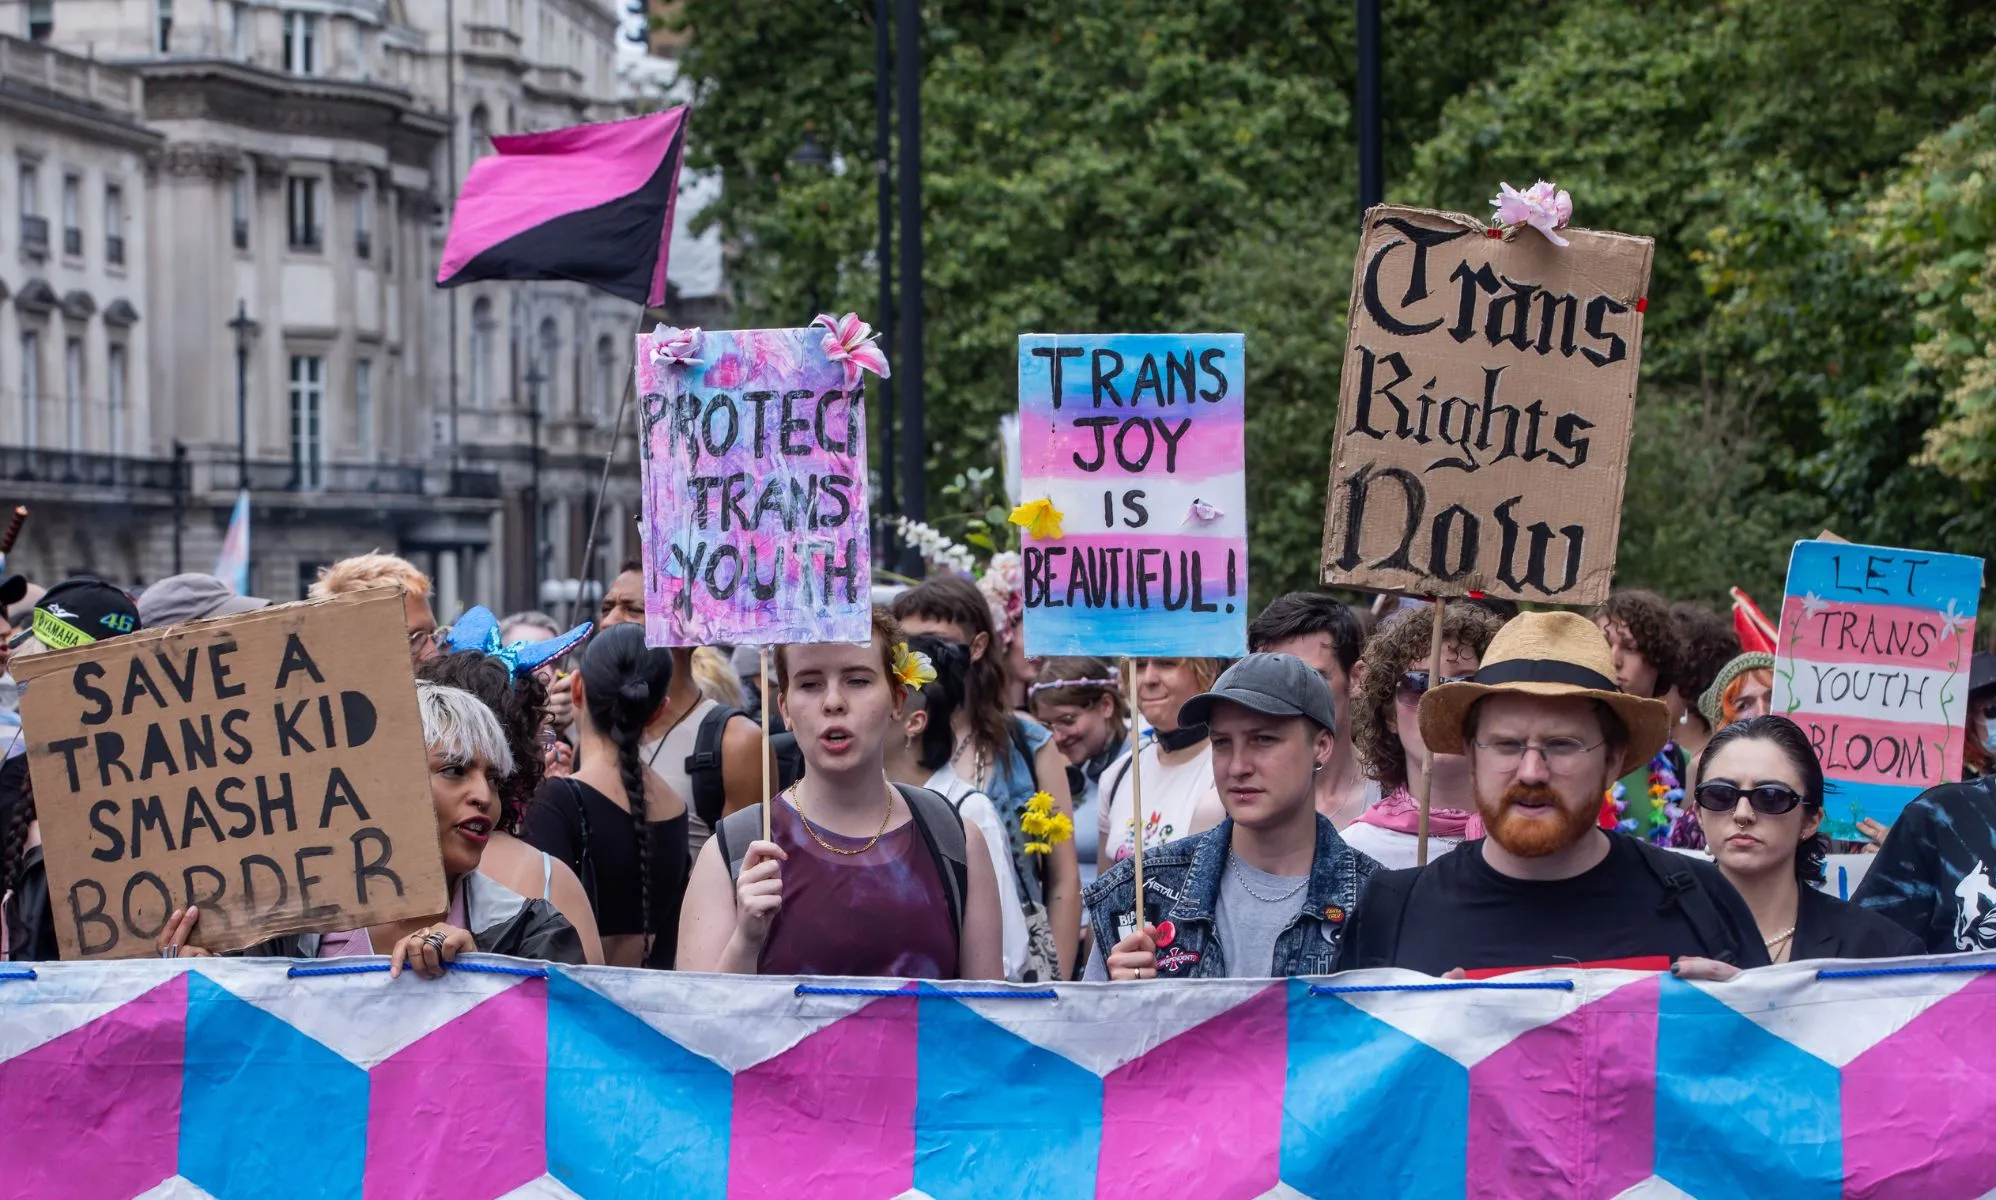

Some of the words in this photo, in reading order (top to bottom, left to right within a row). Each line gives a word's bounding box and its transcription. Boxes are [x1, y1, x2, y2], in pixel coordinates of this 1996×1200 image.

[1362, 216, 1629, 368] Trans
[1031, 346, 1228, 408] TRANS
[1345, 343, 1597, 473] Rights
[640, 388, 864, 459] PROTECT
[1072, 416, 1192, 473] JOY
[687, 472, 854, 532] TRANS
[1104, 489, 1149, 528] IS
[1335, 461, 1586, 595] Now
[670, 538, 857, 614] YOUTH
[1022, 545, 1237, 614] BEAUTIFUL!
[1832, 555, 1930, 597] LET
[44, 620, 80, 646] YAMAHA
[99, 613, 135, 632] 46
[1814, 610, 1937, 657] TRANS
[72, 640, 246, 725] SAVE
[275, 632, 325, 689] A
[1811, 664, 1930, 710] YOUTH
[48, 708, 252, 793] TRANS
[274, 690, 378, 757] KID
[1808, 723, 1929, 779] BLOOM
[88, 772, 298, 862] SMASH
[318, 767, 371, 829] A
[69, 826, 405, 956] BORDER
